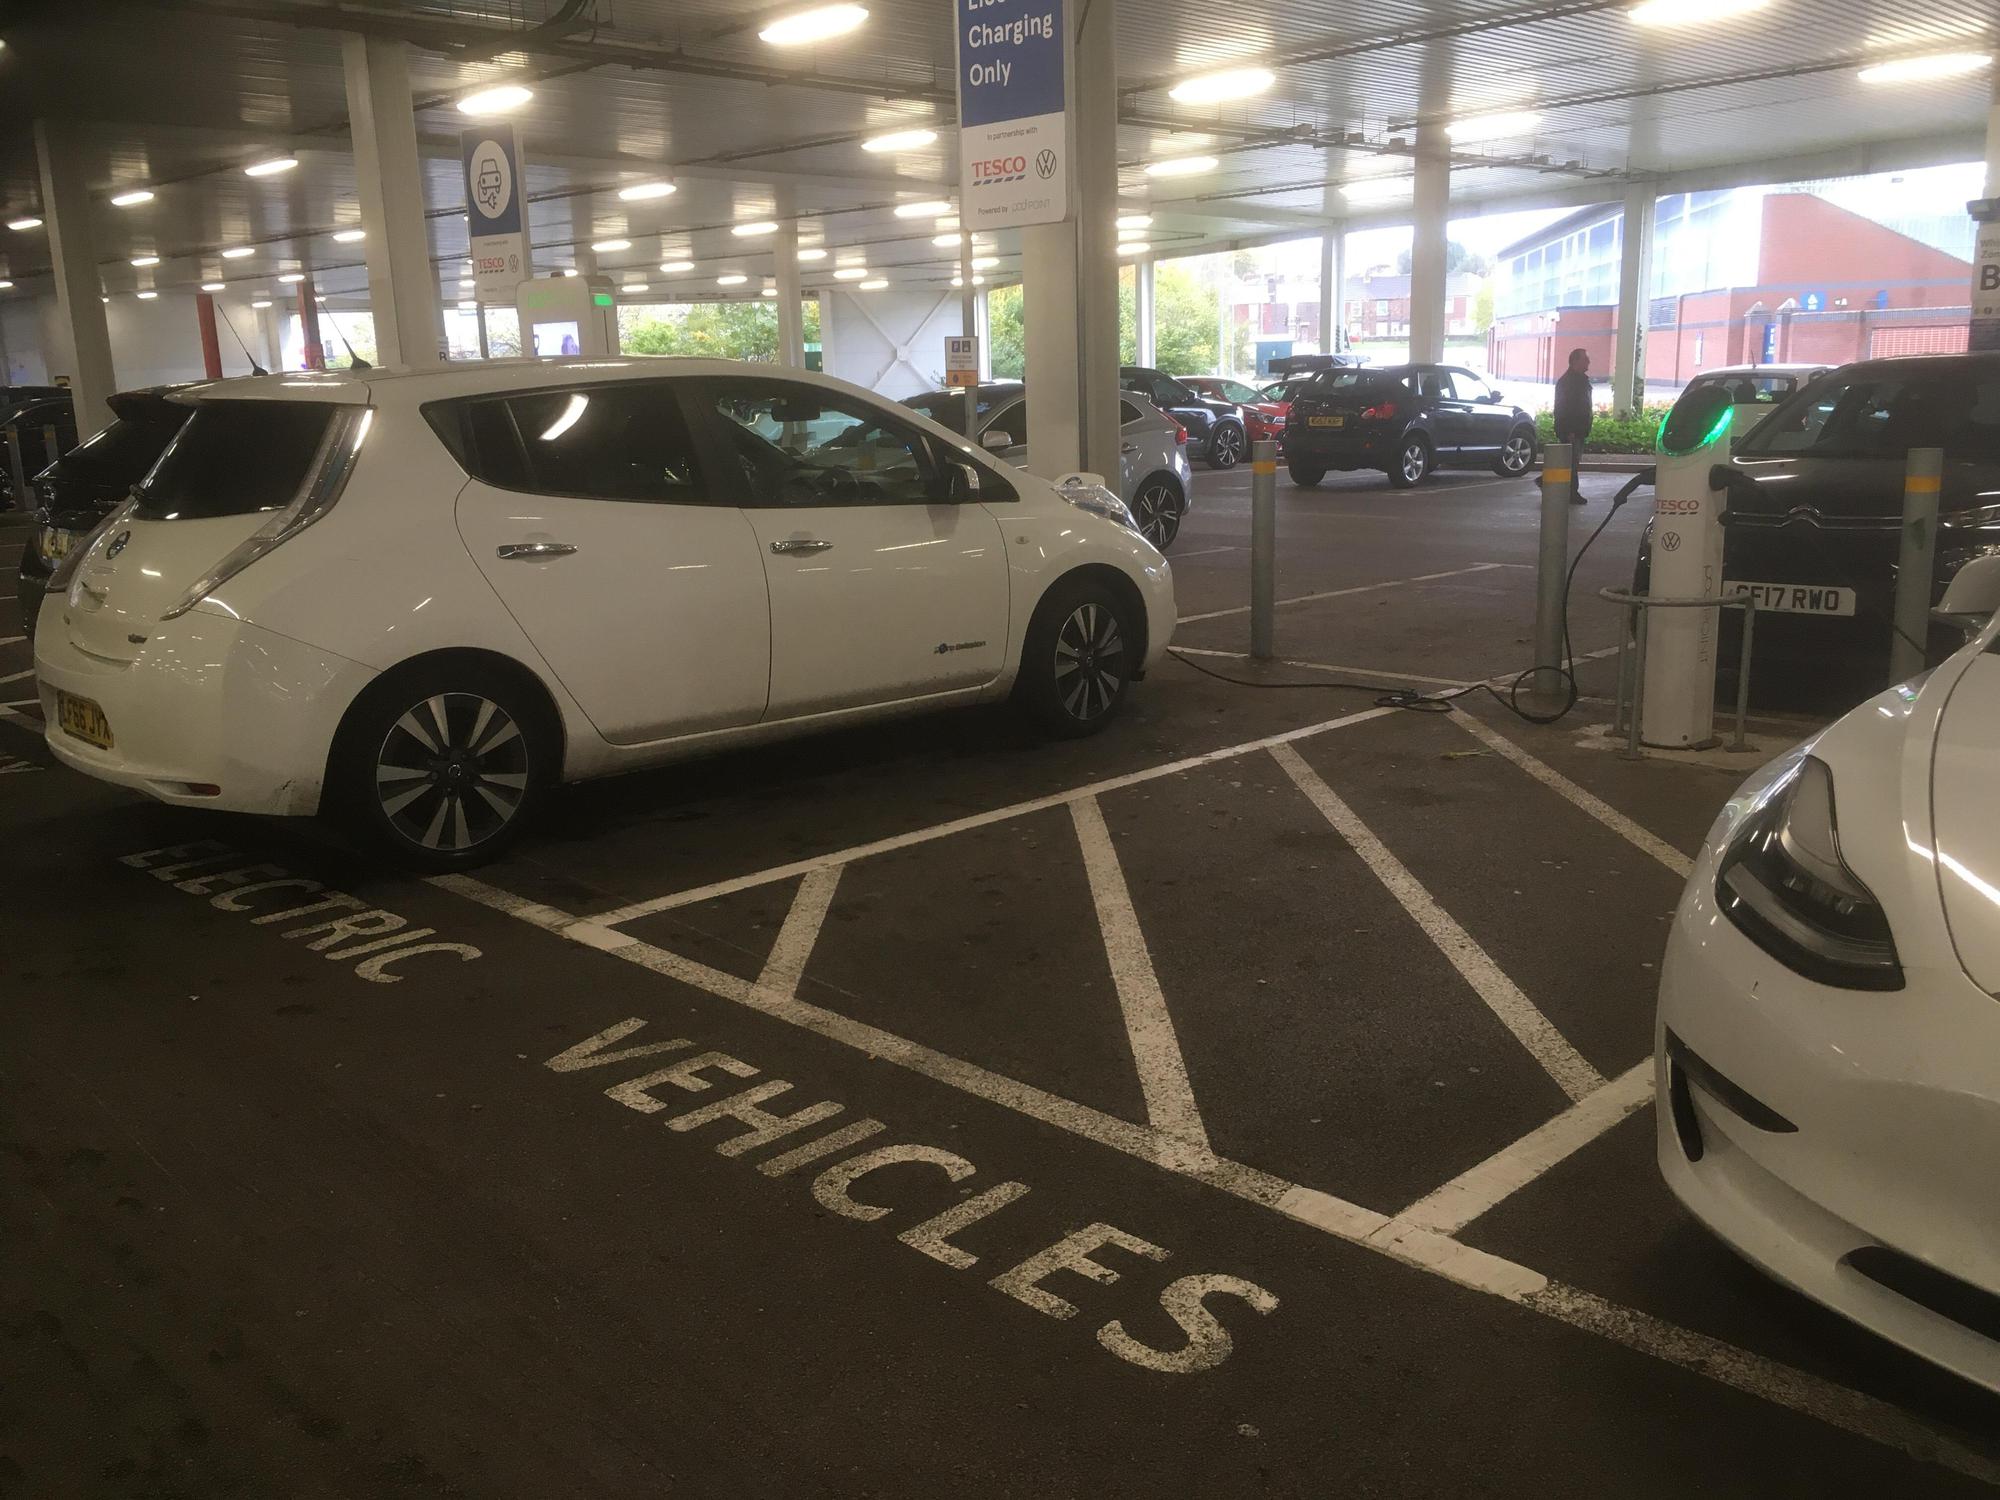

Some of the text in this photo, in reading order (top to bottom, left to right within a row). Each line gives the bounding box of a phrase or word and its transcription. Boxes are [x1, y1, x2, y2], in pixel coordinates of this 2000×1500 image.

[968, 13, 1053, 48] Charging
[969, 59, 1012, 87] Only
[993, 129, 1024, 141] partnership
[971, 156, 1026, 178] TESCO
[978, 206, 1000, 215] Powered
[477, 257, 505, 270] TESCO
[1655, 499, 1699, 511] TESCO
[1792, 588, 1840, 611] RWO
[115, 839, 483, 983] ELECTRIC
[543, 1016, 1280, 1374] VEHICLES
